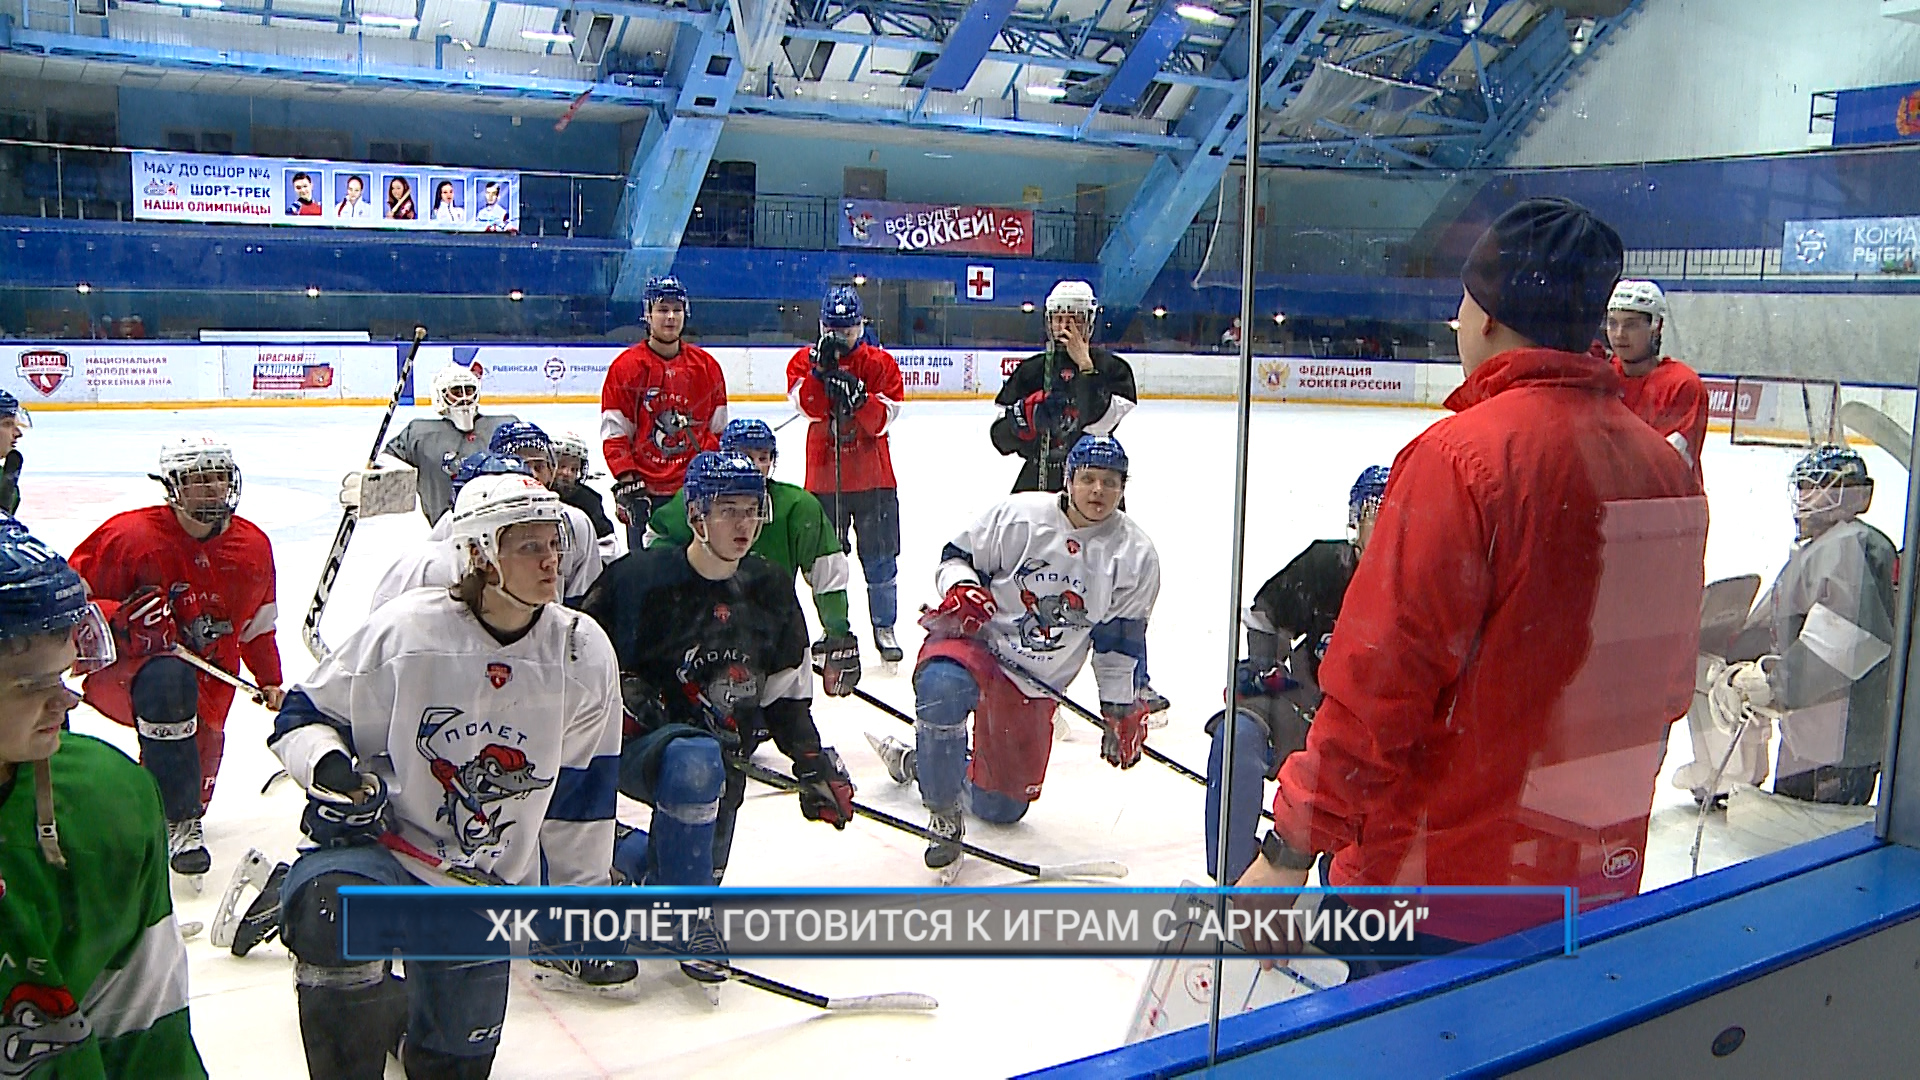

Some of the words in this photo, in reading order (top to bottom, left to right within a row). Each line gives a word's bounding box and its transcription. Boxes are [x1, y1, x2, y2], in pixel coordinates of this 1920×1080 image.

[144, 161, 175, 174] МАУ
[178, 163, 199, 178] ДО
[203, 165, 245, 178] СШОР
[249, 167, 271, 179] №4
[190, 183, 271, 198] ШОРТ-ТРЕК
[143, 199, 184, 211] НАШИ
[187, 201, 271, 216] ОЛИМПИЙЦЫ
[916, 206, 961, 228] БУДЕТ
[896, 208, 997, 250] ХОККЕЙ!
[1854, 226, 1920, 244] КОМА
[85, 357, 168, 365] НАЦИОНАЛЬНАЯ
[927, 356, 954, 368] ЗДЕСЬ
[1299, 365, 1372, 377] ФЕДЕРАЦИЯ
[1299, 379, 1347, 388] ХОККЕЯ
[1350, 380, 1402, 390] РОССИИ
[444, 720, 528, 746] ПОЛЕТ
